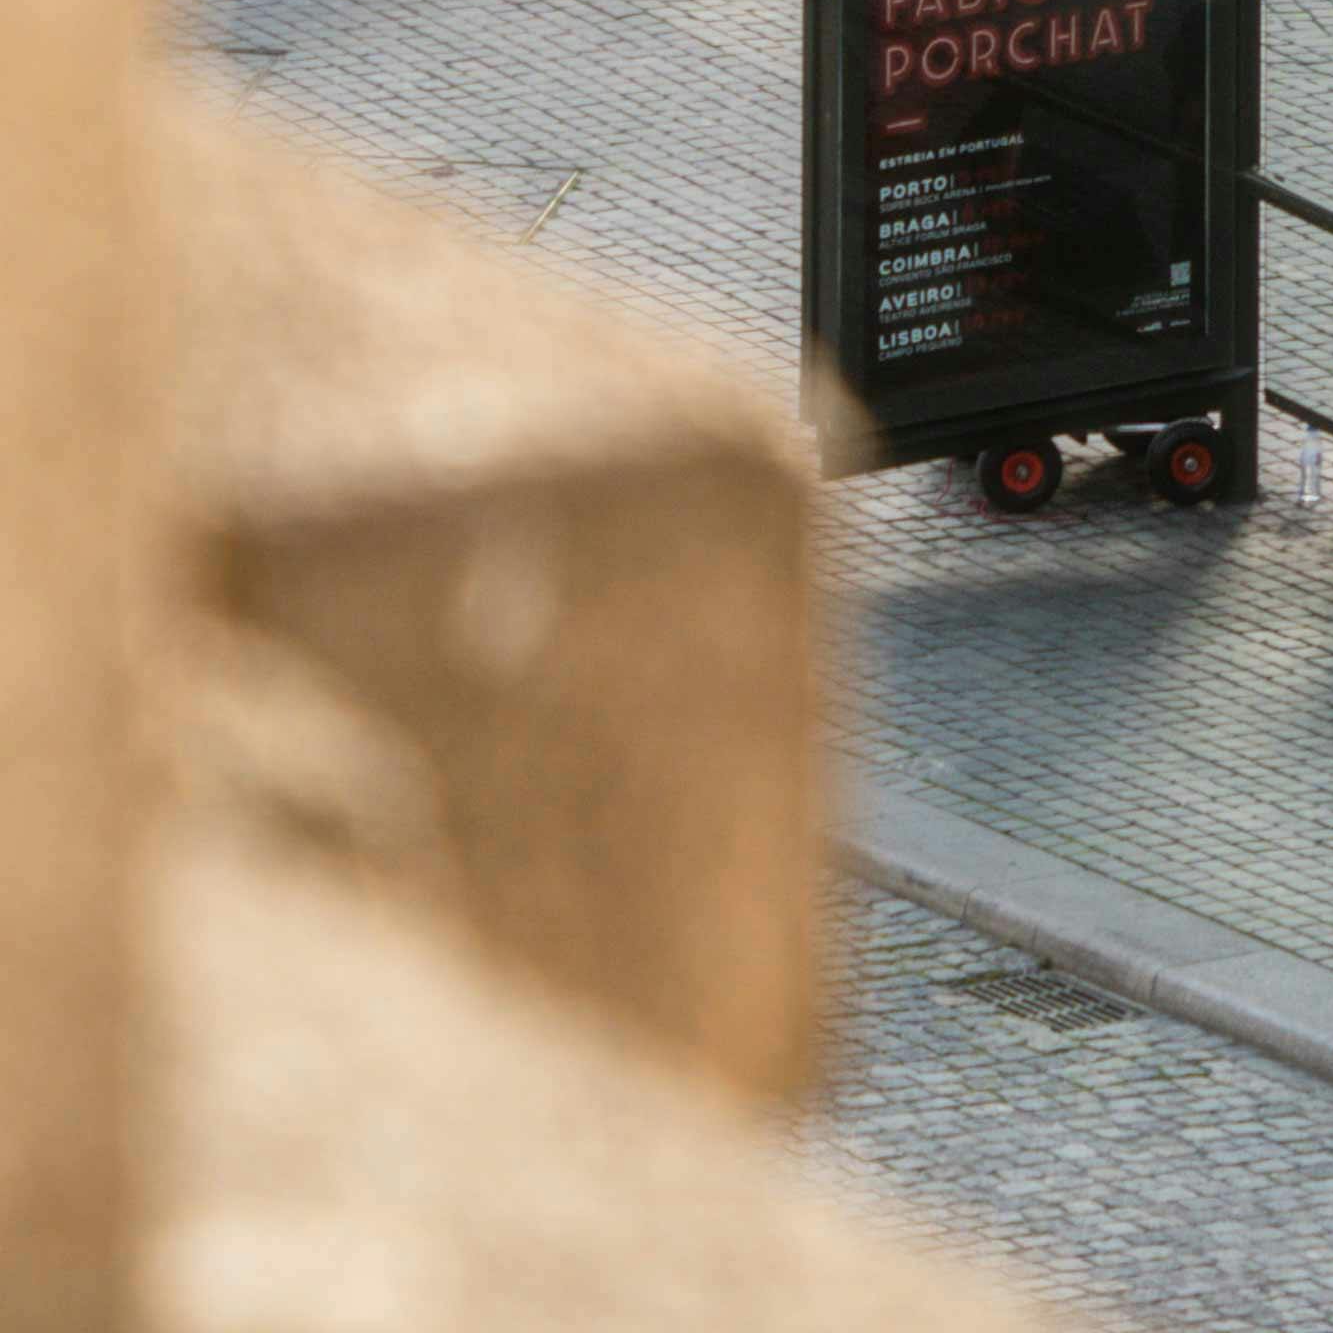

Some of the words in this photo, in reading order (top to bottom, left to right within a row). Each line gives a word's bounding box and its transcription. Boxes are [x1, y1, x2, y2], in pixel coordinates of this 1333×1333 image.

[885, 0, 1149, 89] PORCHAT
[879, 150, 936, 171] ESTREIA
[938, 146, 957, 159] EM
[959, 133, 1026, 154] PORTUGAL
[879, 175, 949, 203] PORTO
[879, 212, 951, 240] BRAGA
[879, 244, 972, 276] COIMBRA
[879, 284, 955, 314] AVEIRO
[879, 321, 952, 351] LISBOA
